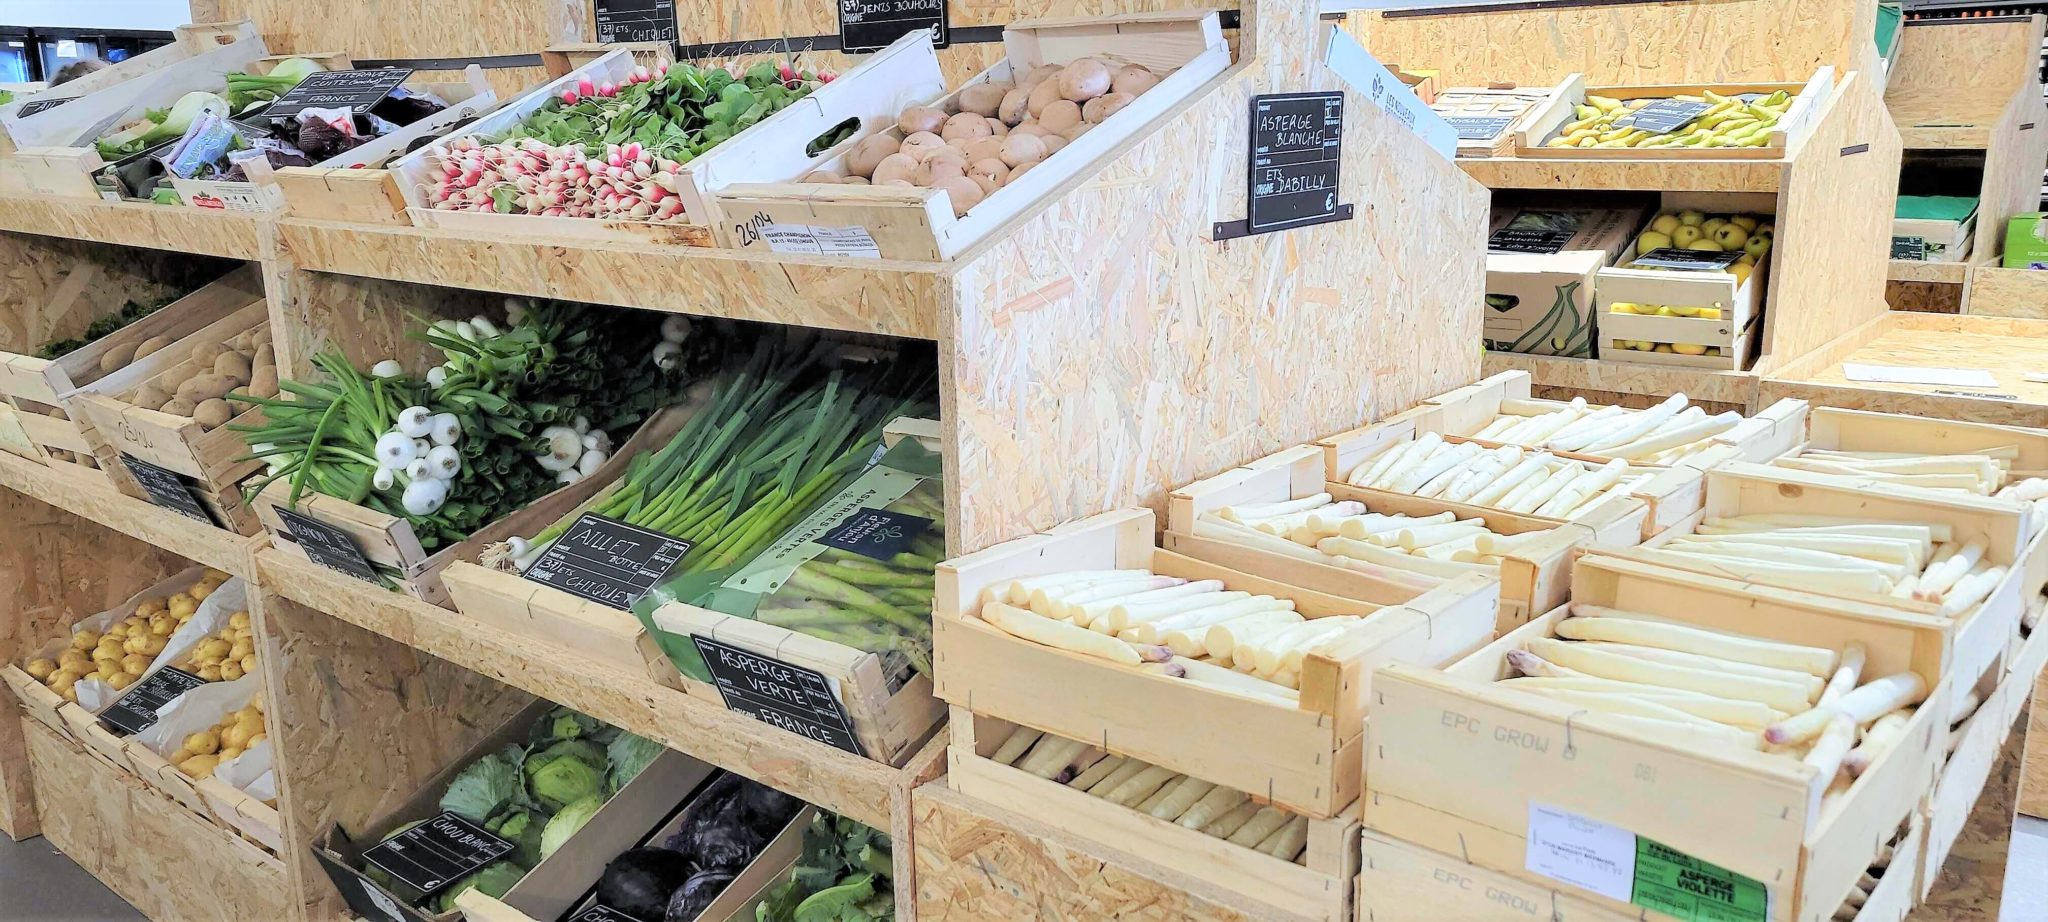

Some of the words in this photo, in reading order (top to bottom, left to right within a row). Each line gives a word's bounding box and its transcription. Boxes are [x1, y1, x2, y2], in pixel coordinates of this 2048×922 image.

[632, 26, 672, 42] CHIQUET
[322, 71, 386, 80] BETTERAVE
[308, 94, 360, 102] FRANCE
[1260, 114, 1312, 132] ASPERGE
[1275, 130, 1324, 148] BLANCHE
[819, 488, 876, 532] ASPERGES
[571, 528, 640, 556] AILLET
[775, 528, 822, 560] VERTES
[848, 517, 892, 544] Fleuron
[609, 554, 643, 570] BOTTE
[566, 576, 630, 604] CHIQUE
[720, 648, 796, 685] ASPERGE
[746, 675, 808, 706] VERTE
[760, 708, 835, 745] FRANCE
[1441, 710, 1480, 734] EPC
[1494, 726, 1550, 752] GROW
[433, 819, 464, 840] CHOU
[459, 833, 492, 852] BLANC
[1433, 868, 1472, 890] EPC
[1485, 886, 1538, 916] GROW
[1677, 878, 1735, 904] VIOLETTE
[1680, 869, 1735, 892] ASPERGE
